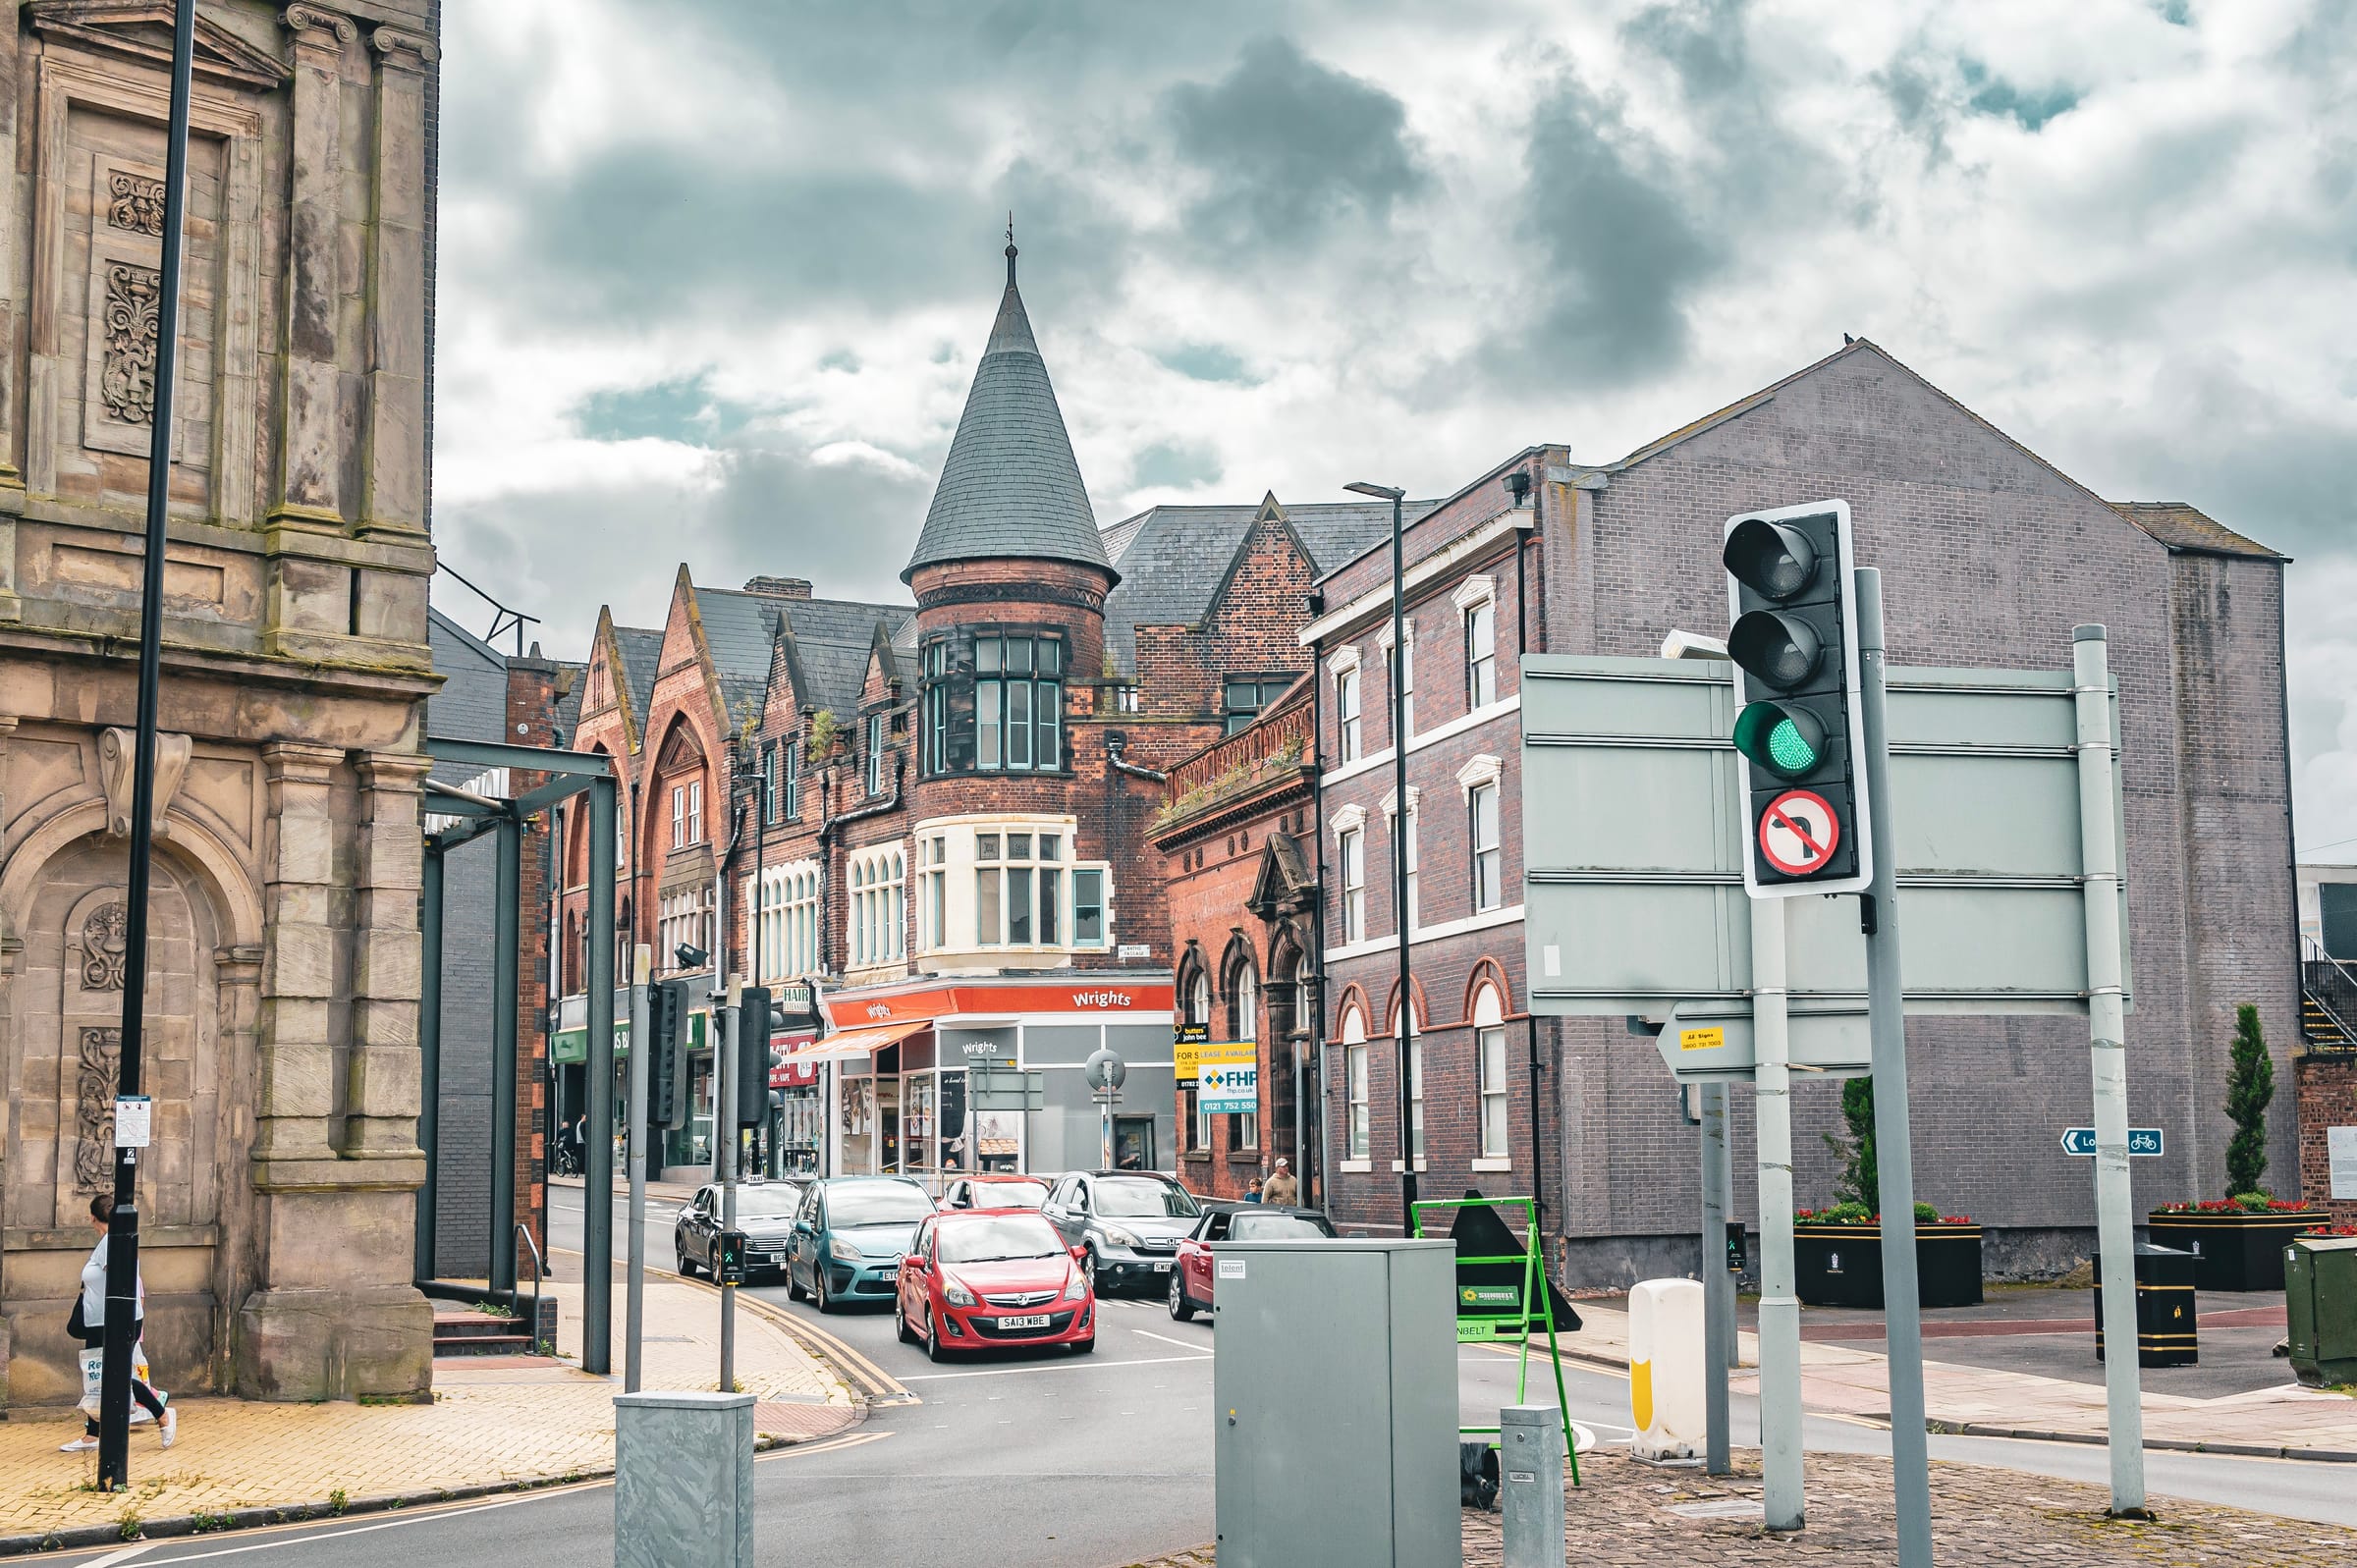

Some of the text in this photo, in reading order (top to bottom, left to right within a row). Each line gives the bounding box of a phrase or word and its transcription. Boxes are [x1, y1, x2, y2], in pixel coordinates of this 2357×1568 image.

[784, 988, 809, 1001] HAIR
[1072, 990, 1131, 1007] Wrights
[784, 1001, 809, 1012] EXTENSIONS
[962, 1041, 998, 1054] Wrights
[1227, 1071, 1257, 1087] FHP
[1224, 1101, 1239, 1109] 752
[1221, 1264, 1243, 1272] telent
[1004, 1316, 1044, 1327] SA13 WBE
